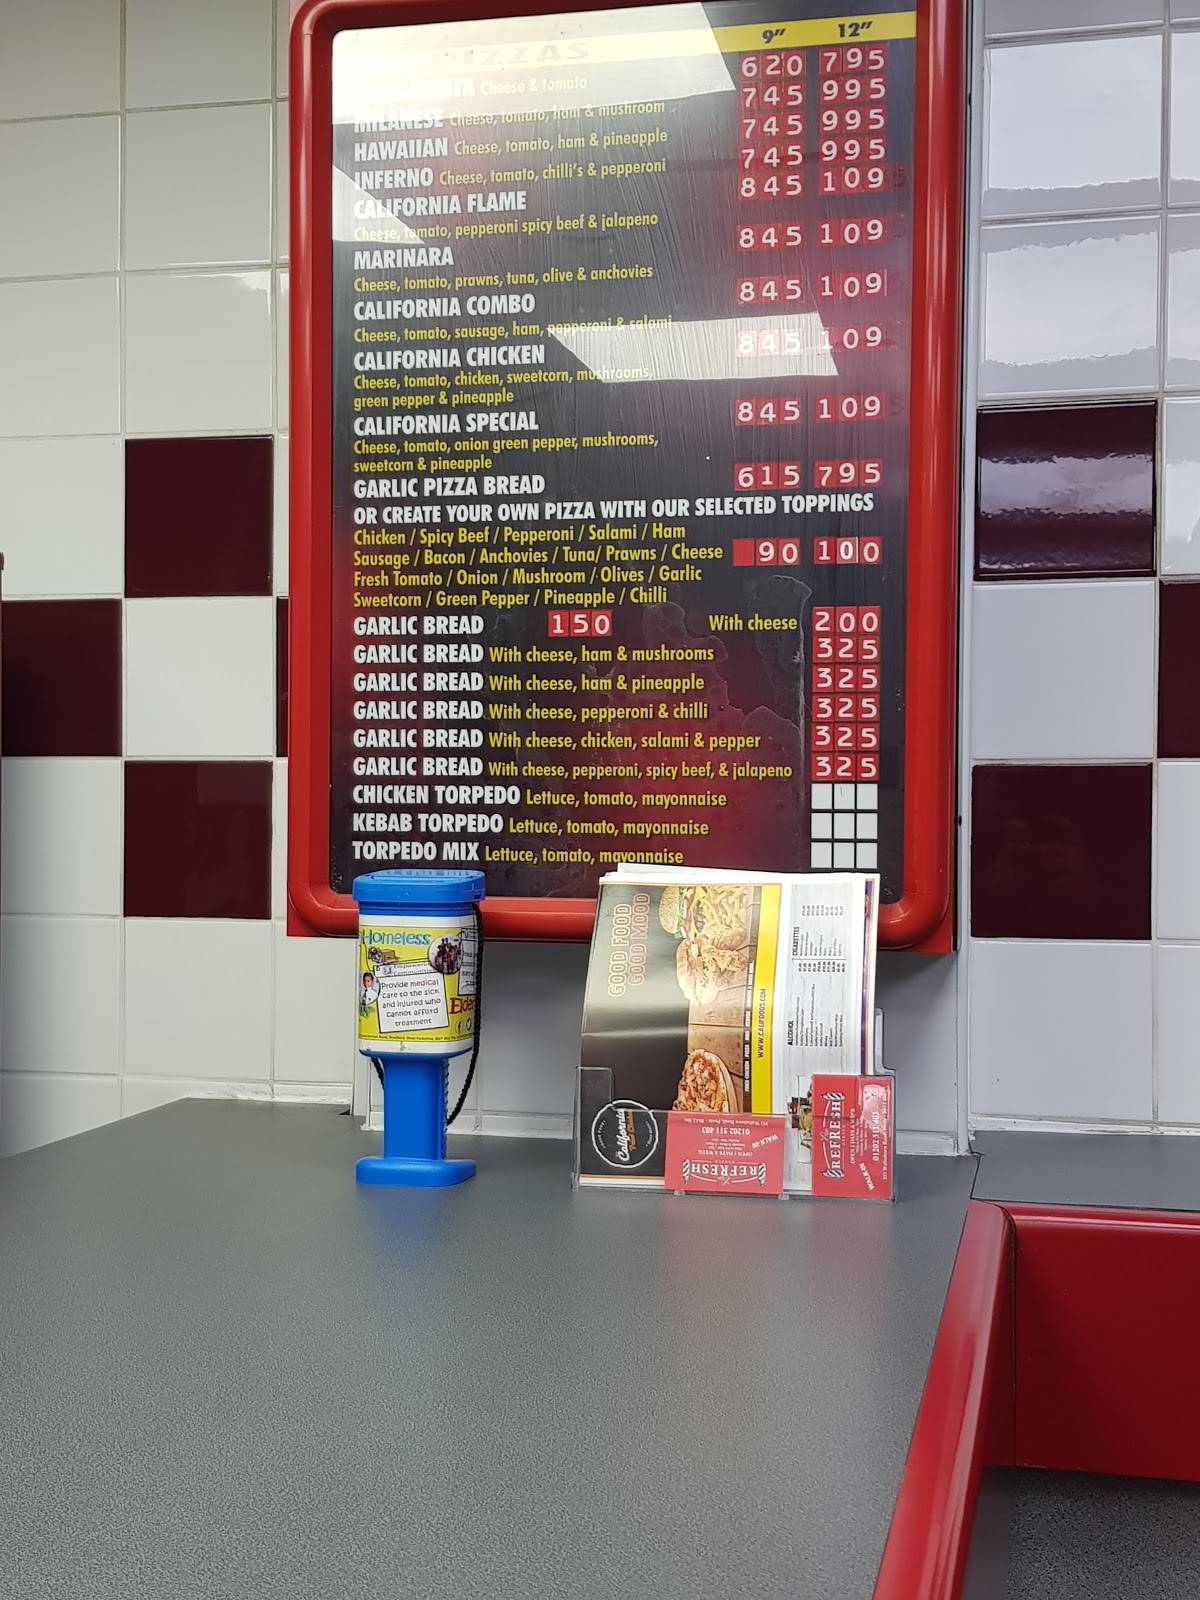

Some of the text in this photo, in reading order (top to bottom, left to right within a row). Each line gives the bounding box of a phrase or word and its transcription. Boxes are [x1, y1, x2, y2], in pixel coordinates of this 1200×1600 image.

[762, 28, 786, 43] 9"
[838, 21, 872, 38] 12"
[742, 55, 802, 77] 620
[824, 48, 884, 72] 795
[481, 78, 525, 95] Cheese
[529, 79, 538, 92] &
[542, 78, 588, 92] tomato
[742, 85, 803, 107] 745
[822, 78, 885, 100] 995
[450, 113, 498, 128] Cheese,
[502, 110, 550, 124] tomato,
[554, 106, 580, 120] ham
[585, 106, 594, 118] &
[598, 101, 665, 116] mushroom
[822, 108, 885, 130] 995
[742, 115, 802, 139] 745
[354, 130, 667, 162] HAWAIIAN Cheese, tomato, ham & pineapple
[742, 145, 802, 169] 745
[822, 138, 885, 161] 995
[354, 158, 666, 191] INFERNO Cheese, tomato, chilli's & pepperoni
[824, 167, 884, 192] 109
[740, 175, 802, 197] 845
[354, 191, 527, 220] CALIFORNIA FLAME
[354, 212, 658, 241] Cheese, tomato, pepperoni spicy beef & jalapeno
[739, 226, 802, 248] 845
[821, 219, 883, 244] 109
[354, 247, 454, 270] MARINARA
[354, 264, 652, 292] Cheese, tomato, prawns, tuna, olive & anchovies
[821, 273, 882, 298] 109
[740, 280, 801, 302] 845
[354, 293, 536, 320] CALIFORNIA COMBO
[354, 314, 672, 344] Cheese, tomato, sausage, ham, pepperoni & salami
[820, 326, 882, 350] 109
[739, 332, 801, 353] 845
[354, 344, 545, 372] CALIFORNIA CHICKEN
[738, 401, 800, 422] 845
[818, 396, 881, 418] 109
[354, 412, 539, 436] CALIFORNIA SPECIAL
[738, 466, 800, 488] 615
[818, 463, 881, 486] 795
[354, 475, 545, 499] GARLIC PIZZA BREAD
[354, 492, 874, 524] OR CREATE YOUR OWN PIZZA WITH OUR SELECTED TOPPINGS
[758, 541, 798, 563] 90
[818, 541, 880, 562] 100
[354, 616, 484, 636] GARLIC BREAD
[552, 614, 611, 635] 150
[709, 614, 797, 631] With cheese
[815, 611, 879, 632] 200
[354, 644, 714, 664] GARLIC BREAD With cheese, ham & mushrooms
[817, 638, 878, 659] 325
[353, 757, 792, 783] GARLIC BREAD With cheese, pepperoni, spicy beef, & jalapeno
[815, 756, 877, 778] 325
[353, 785, 727, 809] CHICKEN TORPEDO Lettuce, tomato, mayonnaise
[352, 841, 436, 860] TORPEDO
[443, 842, 479, 860] MIX
[485, 846, 538, 864] Lettuce,
[542, 846, 595, 864] tomato,
[361, 930, 430, 945] Homeless
[629, 893, 649, 986] GOOD MOOD
[608, 904, 632, 998] GOOD FOOD
[382, 978, 439, 990] Provide medical
[382, 990, 398, 999] care
[382, 1000, 395, 1009] and
[386, 1007, 438, 1018] cannot afford
[395, 1018, 432, 1026] treatment
[616, 1109, 630, 1161] California
[829, 1101, 841, 1169] REFRESH
[691, 1163, 757, 1176] REFRESH
